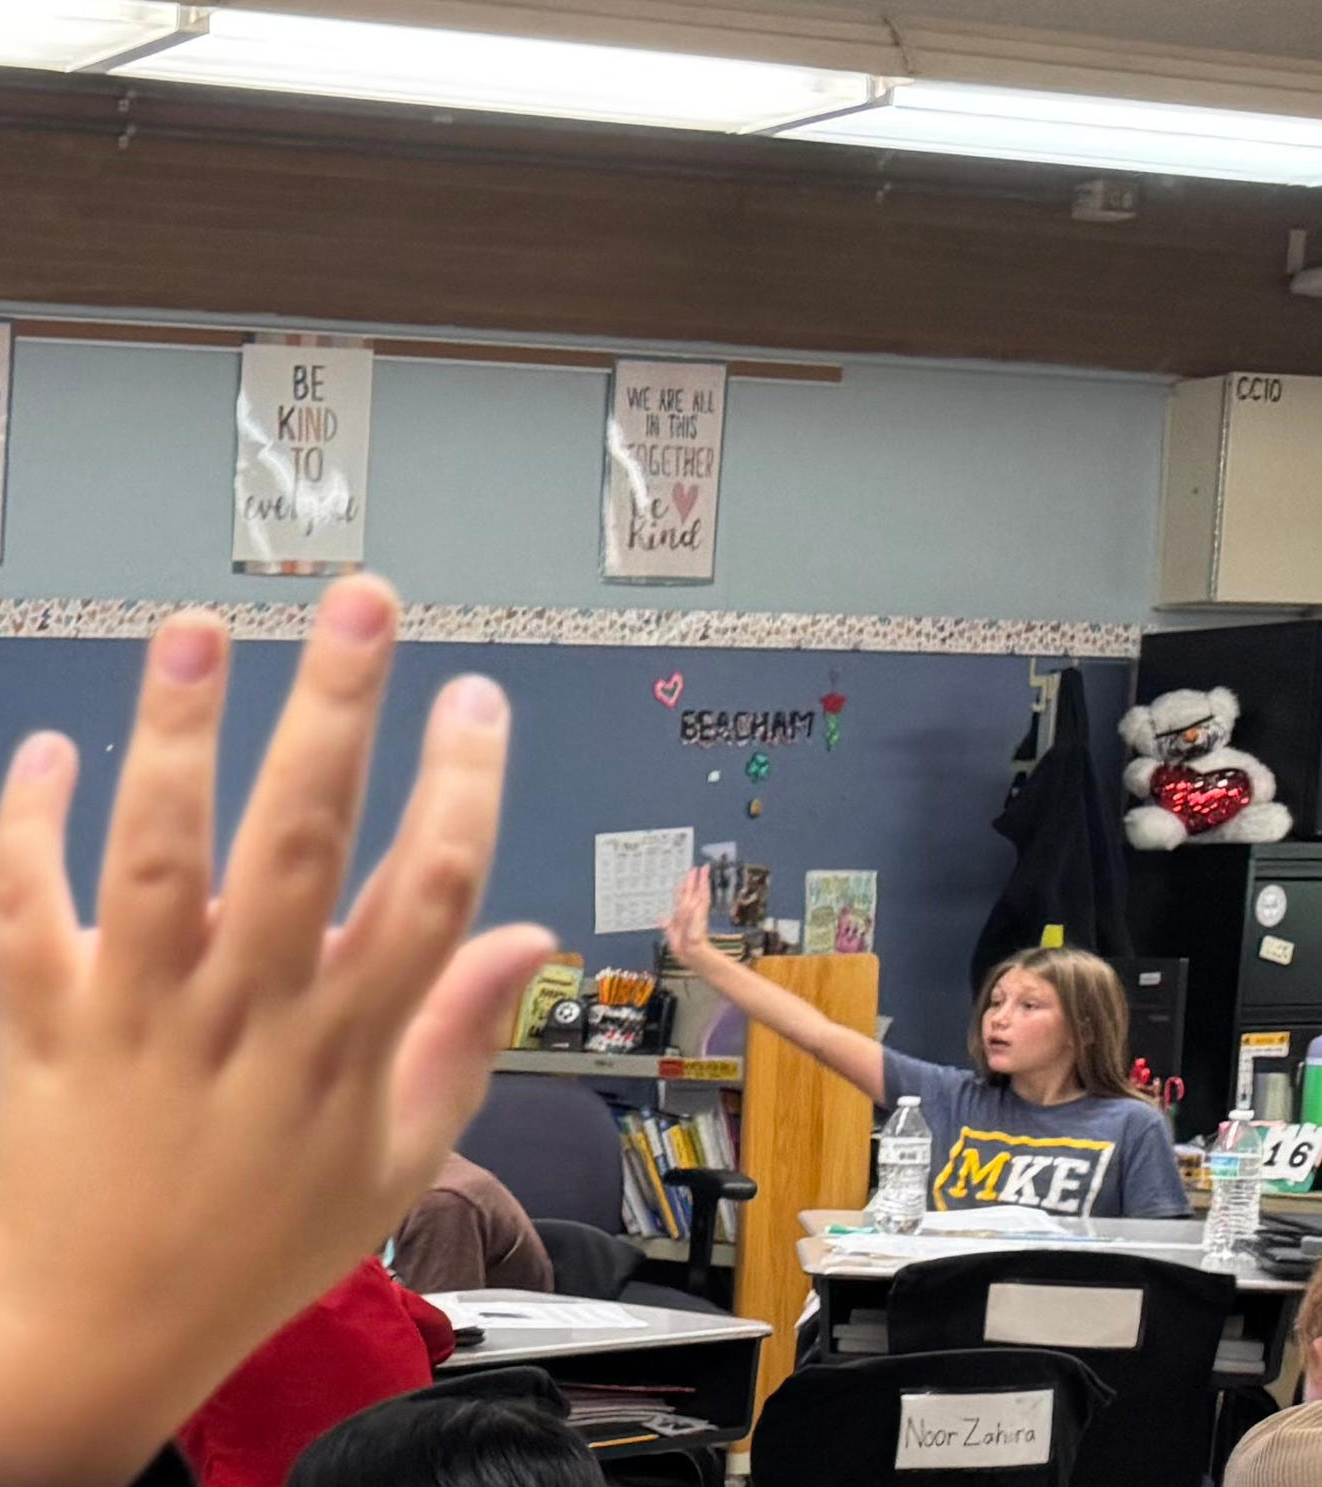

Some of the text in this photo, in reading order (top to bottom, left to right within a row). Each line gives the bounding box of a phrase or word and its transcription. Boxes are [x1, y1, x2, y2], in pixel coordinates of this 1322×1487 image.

[293, 364, 326, 402] BE
[627, 387, 715, 414] WE ARE ALL
[277, 404, 338, 443] KIND
[645, 413, 698, 440] IN THIS
[290, 446, 324, 483] TO
[680, 709, 816, 742] BEACHAM
[1262, 1140, 1314, 1168] 16
[948, 1147, 1091, 1214] MKE
[904, 1416, 1036, 1449] Noor Zahira
